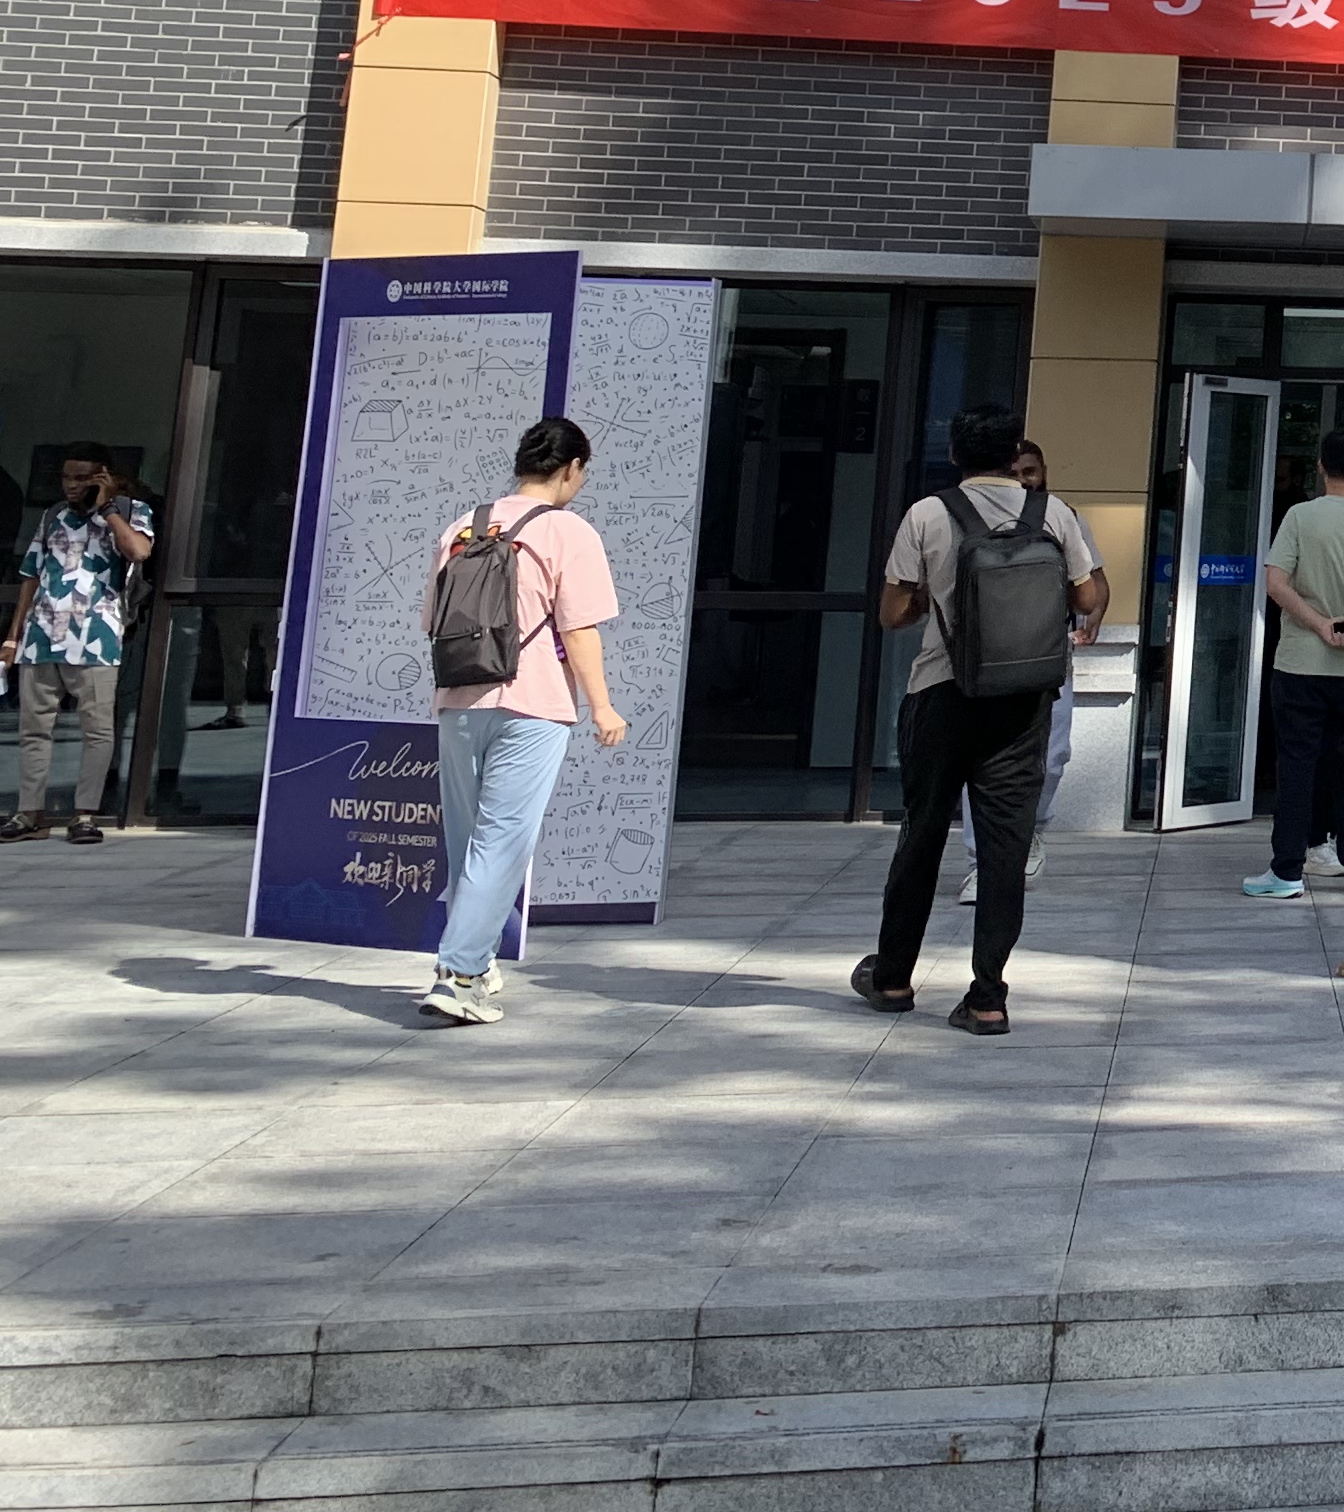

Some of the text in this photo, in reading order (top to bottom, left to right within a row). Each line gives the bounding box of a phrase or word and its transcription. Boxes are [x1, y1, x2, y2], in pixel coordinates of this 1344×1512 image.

[325, 740, 440, 781] Welcom
[330, 798, 443, 826] NEW STUDEN
